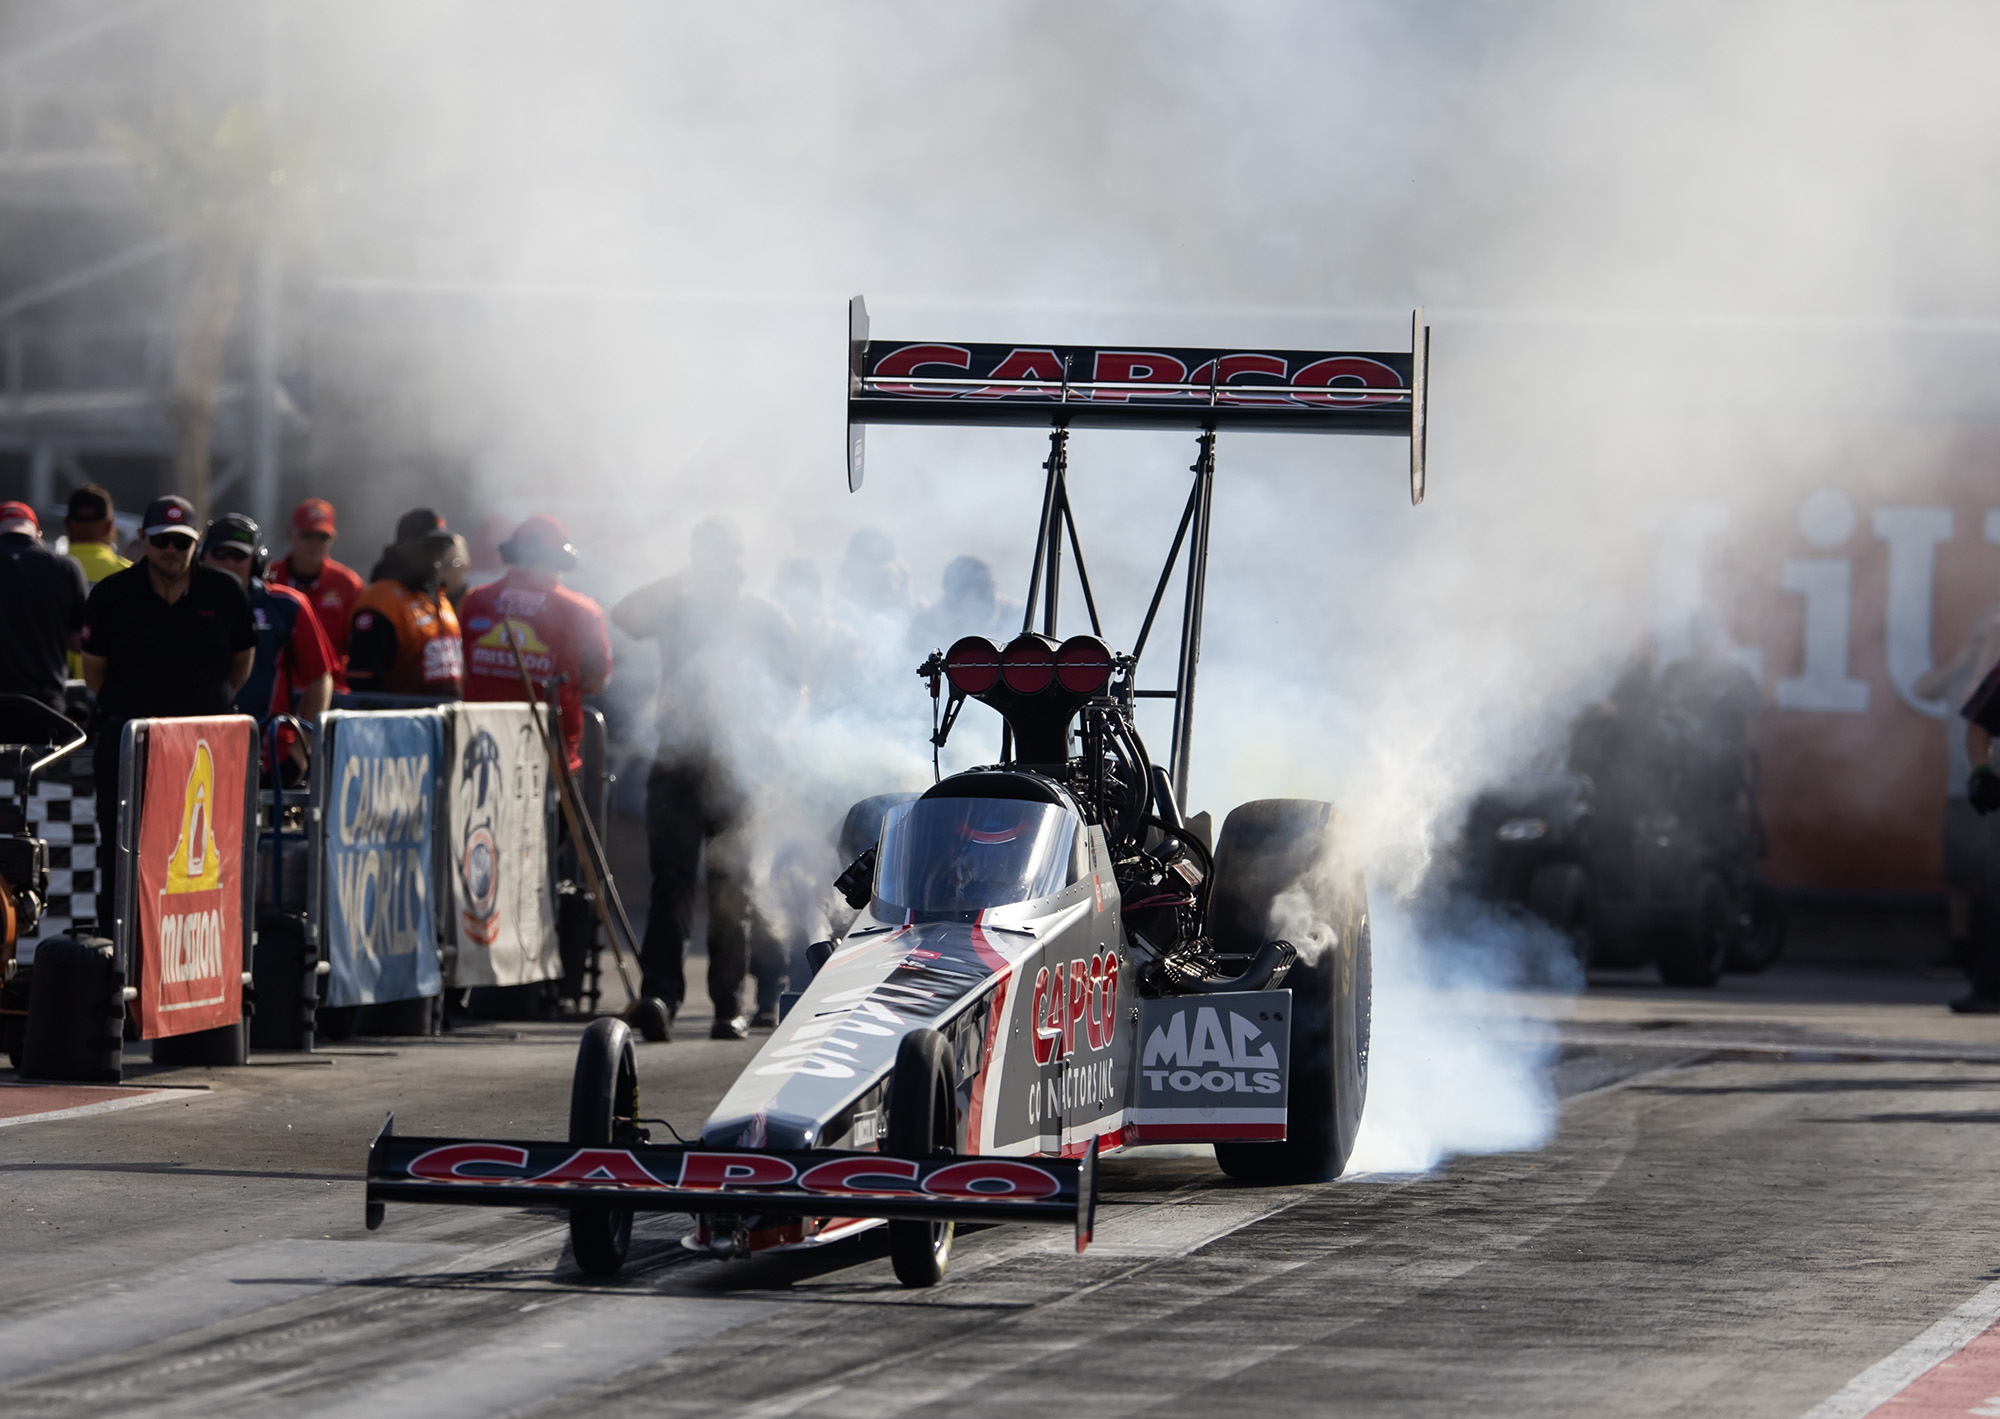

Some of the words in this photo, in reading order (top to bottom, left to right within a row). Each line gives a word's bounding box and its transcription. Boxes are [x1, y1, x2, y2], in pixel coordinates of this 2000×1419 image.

[873, 343, 1404, 408] CAPCO
[337, 848, 426, 960] WORLD
[1031, 950, 1118, 1067] CAPCO
[1142, 1006, 1280, 1069] MAC
[1098, 1057, 1114, 1099] INC
[1142, 1070, 1282, 1094] TOOLS
[406, 1142, 1062, 1198] CAPCO
